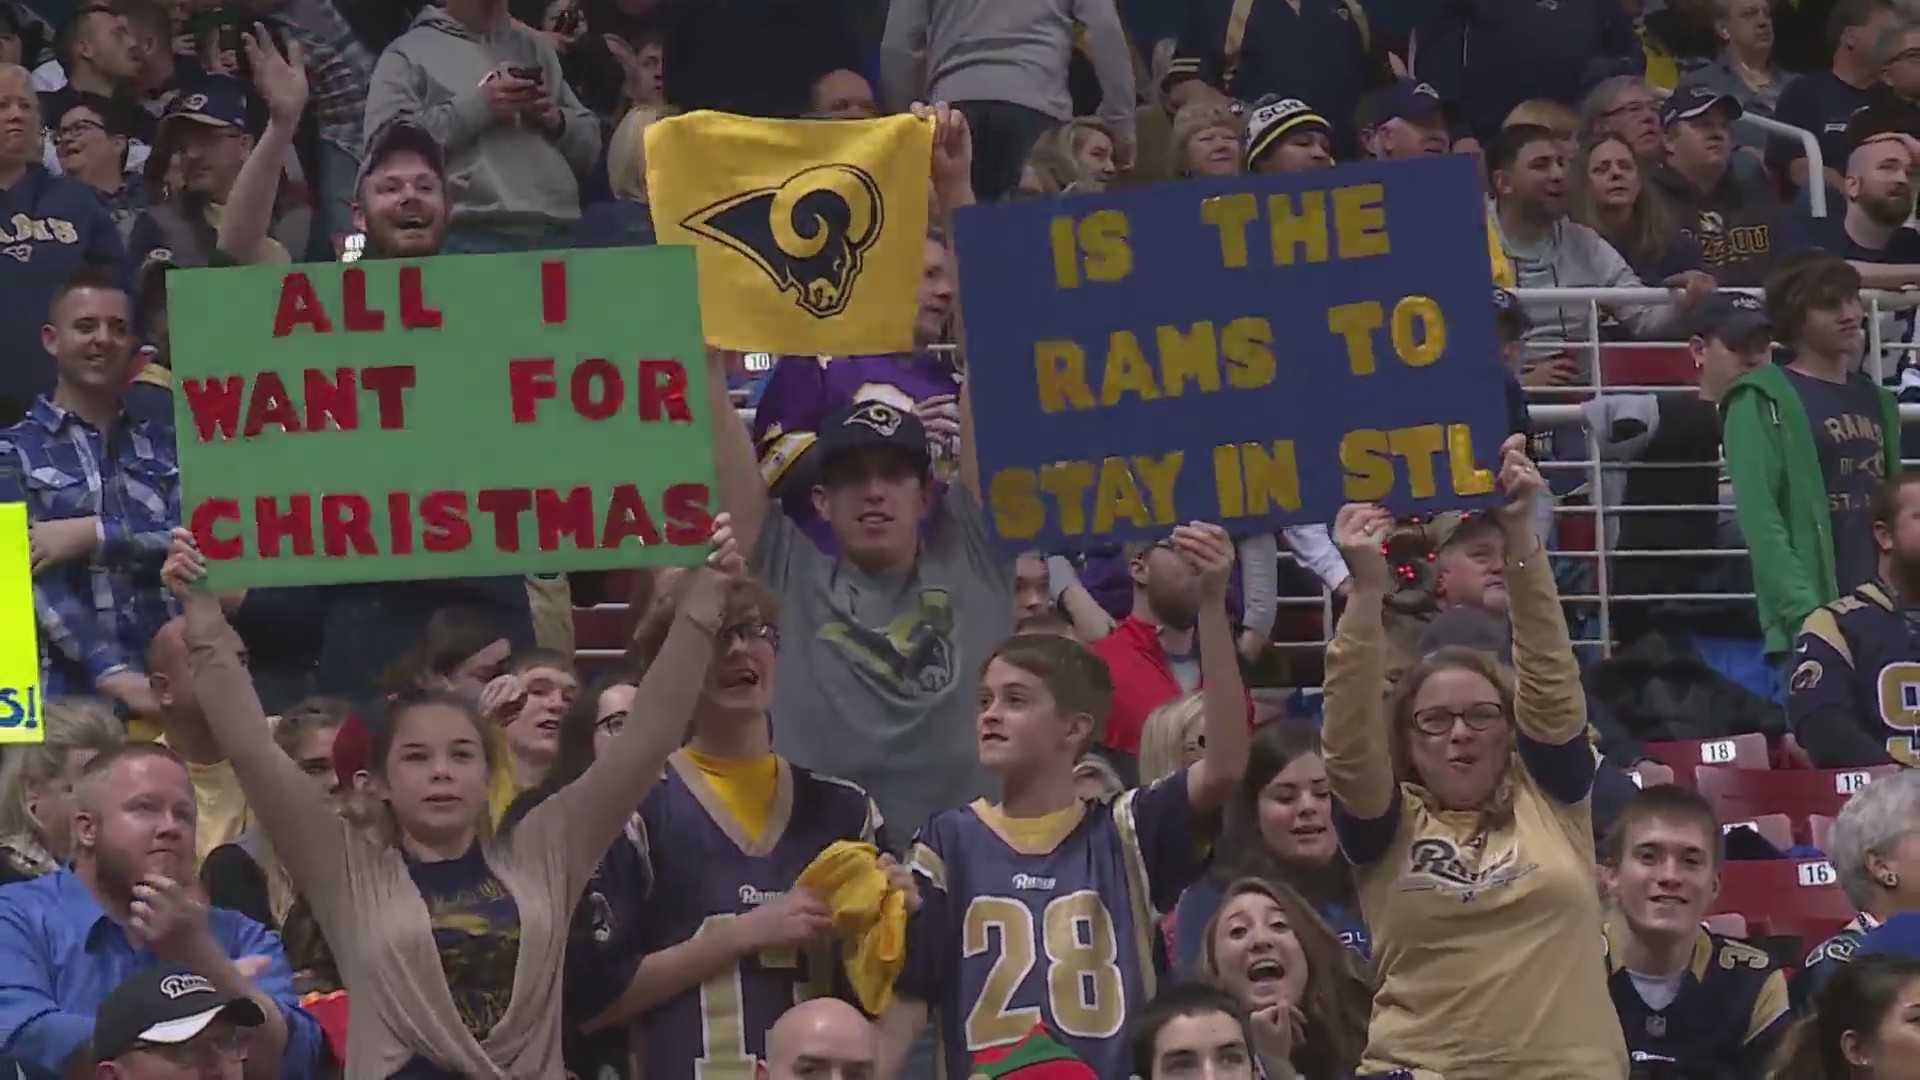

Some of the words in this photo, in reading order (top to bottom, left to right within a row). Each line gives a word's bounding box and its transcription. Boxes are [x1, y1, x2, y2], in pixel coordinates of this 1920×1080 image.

[1049, 208, 1135, 289] IS
[1201, 182, 1391, 269] THE
[272, 266, 443, 337] ALL
[540, 260, 567, 325] I
[1034, 315, 1278, 414] RAMS
[1327, 295, 1449, 376] TO
[180, 364, 417, 443] WANT
[508, 358, 694, 424] FOR
[190, 482, 717, 562] CHRISTMAS
[989, 449, 1185, 540] STAY
[1212, 439, 1302, 518] IN
[1338, 423, 1495, 502] STL
[1709, 743, 1730, 760] 18
[1845, 772, 1865, 791] 18
[1806, 864, 1829, 883] 16
[962, 887, 1126, 1052] 28
